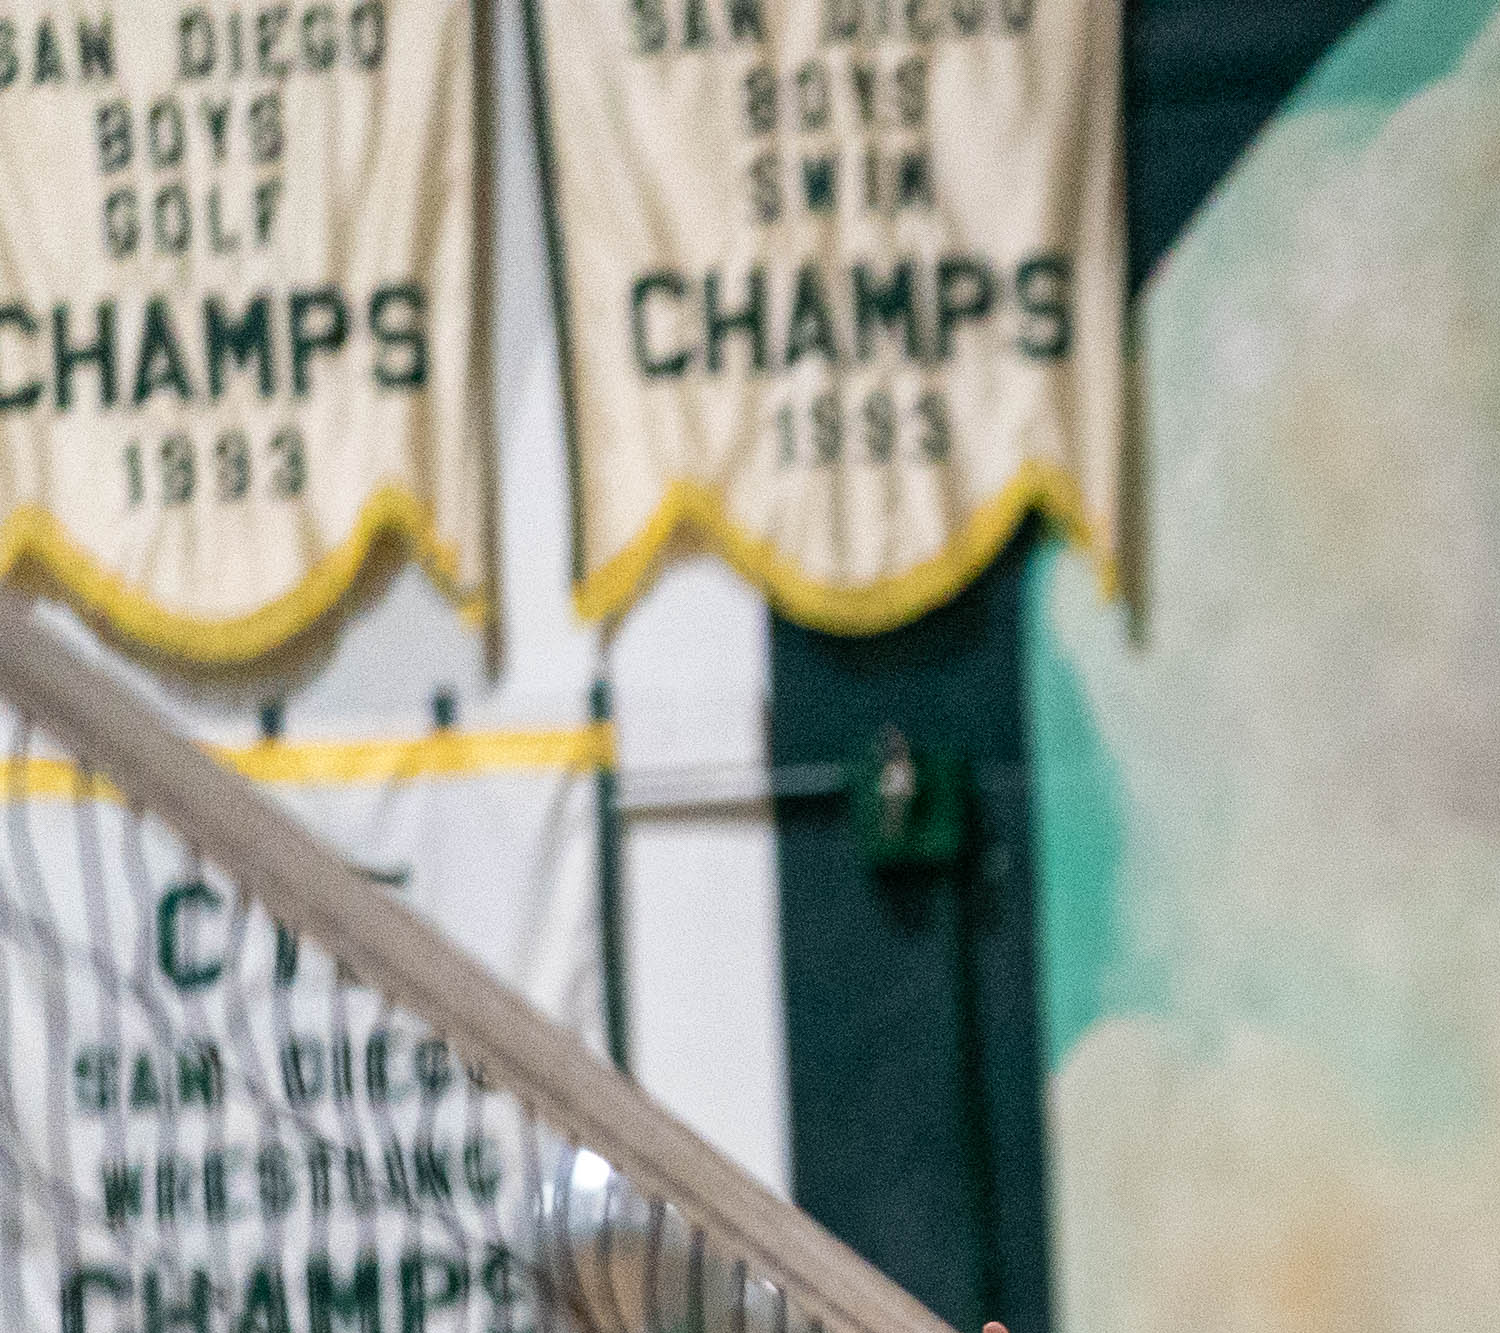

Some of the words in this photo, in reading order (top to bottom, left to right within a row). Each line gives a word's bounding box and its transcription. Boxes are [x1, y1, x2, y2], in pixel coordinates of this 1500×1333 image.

[177, 4, 388, 80] DIEGO
[96, 96, 286, 174] BOYS
[742, 60, 930, 136] BOYS
[100, 180, 282, 258] GOLF
[748, 148, 938, 226] SWIM
[0, 280, 432, 412] CHAMPS
[630, 250, 1076, 380] CHAMPS
